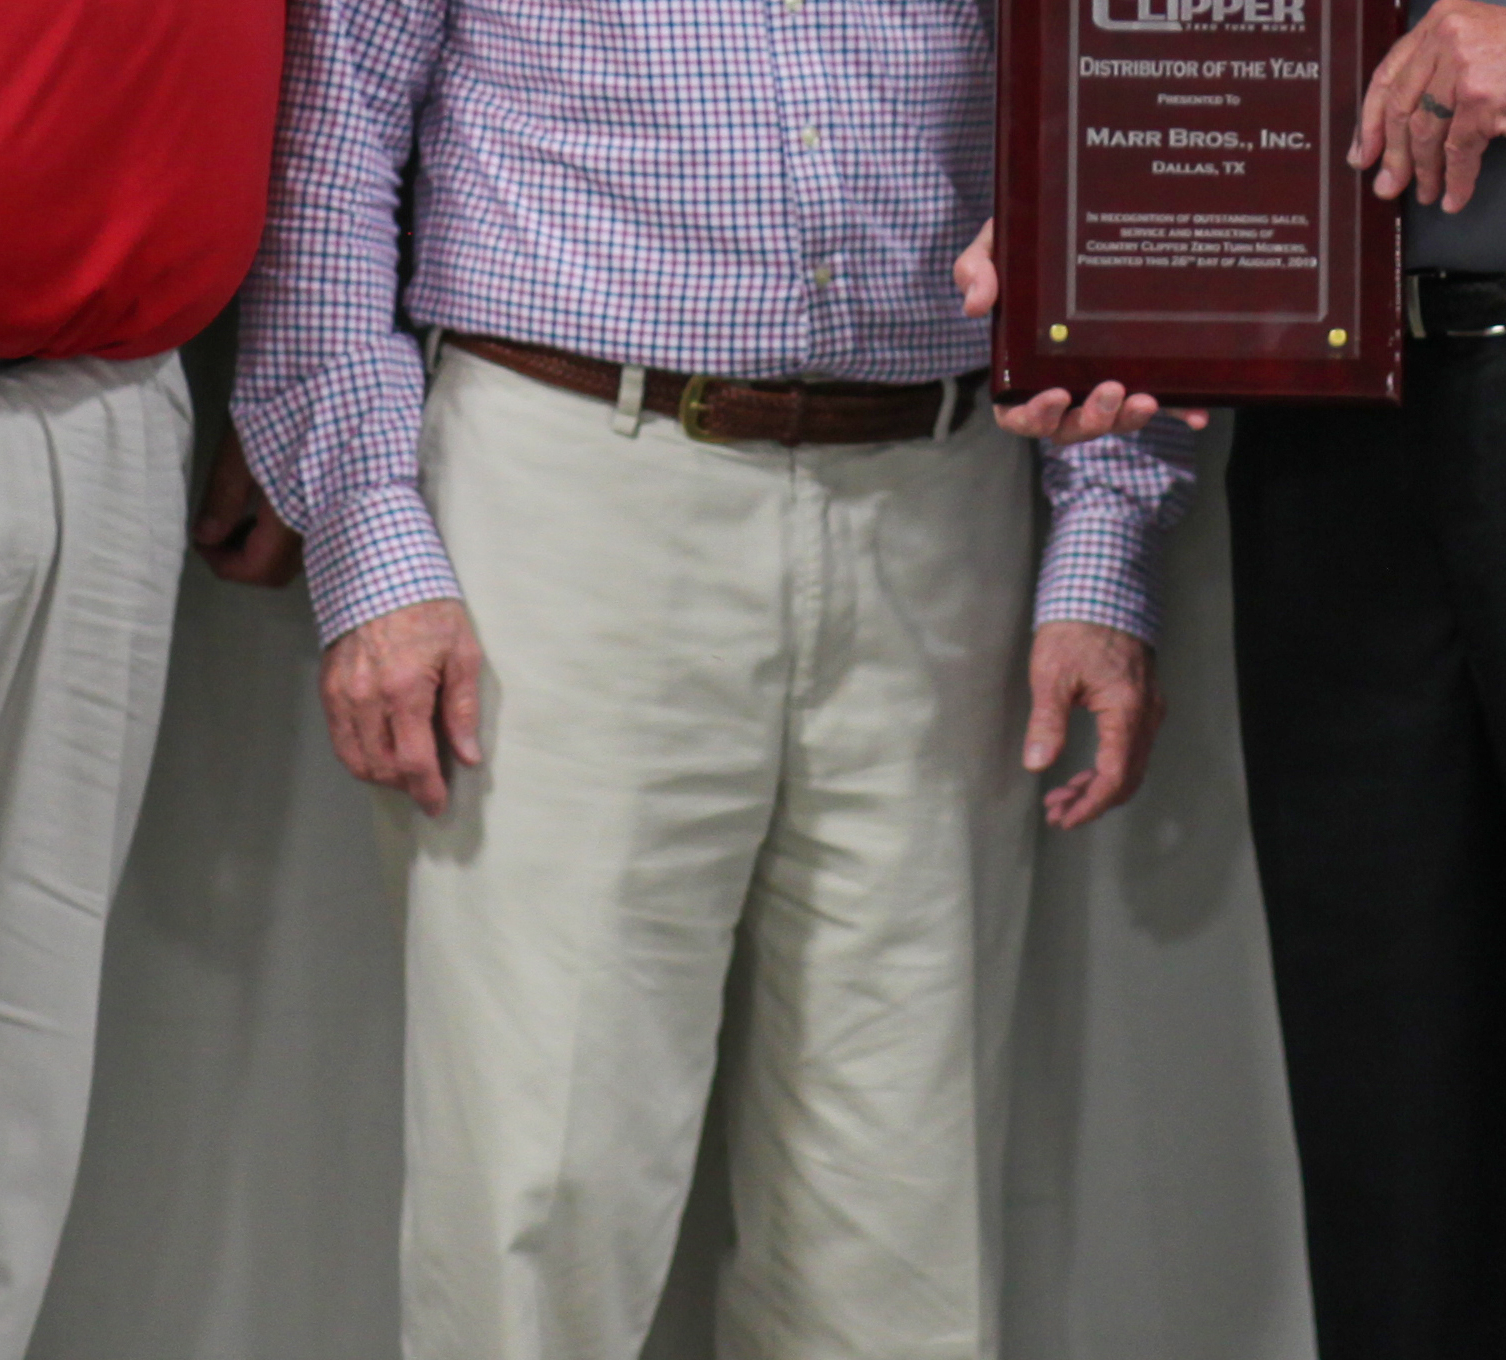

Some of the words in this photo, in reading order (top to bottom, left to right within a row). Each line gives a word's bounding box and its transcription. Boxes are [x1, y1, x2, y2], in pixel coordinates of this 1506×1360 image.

[1079, 56, 1199, 78] DISTRIBUTOR
[1202, 60, 1227, 78] OF
[1230, 60, 1266, 79] THE
[1270, 57, 1319, 79] YEAR
[1157, 93, 1223, 106] PRESENTED
[1226, 93, 1241, 106] TO
[1086, 127, 1162, 148] MARR
[1168, 127, 1253, 152] BROS.,
[1260, 128, 1312, 149] INC.
[1152, 160, 1219, 176] DALLAS,
[1222, 160, 1245, 175] TX
